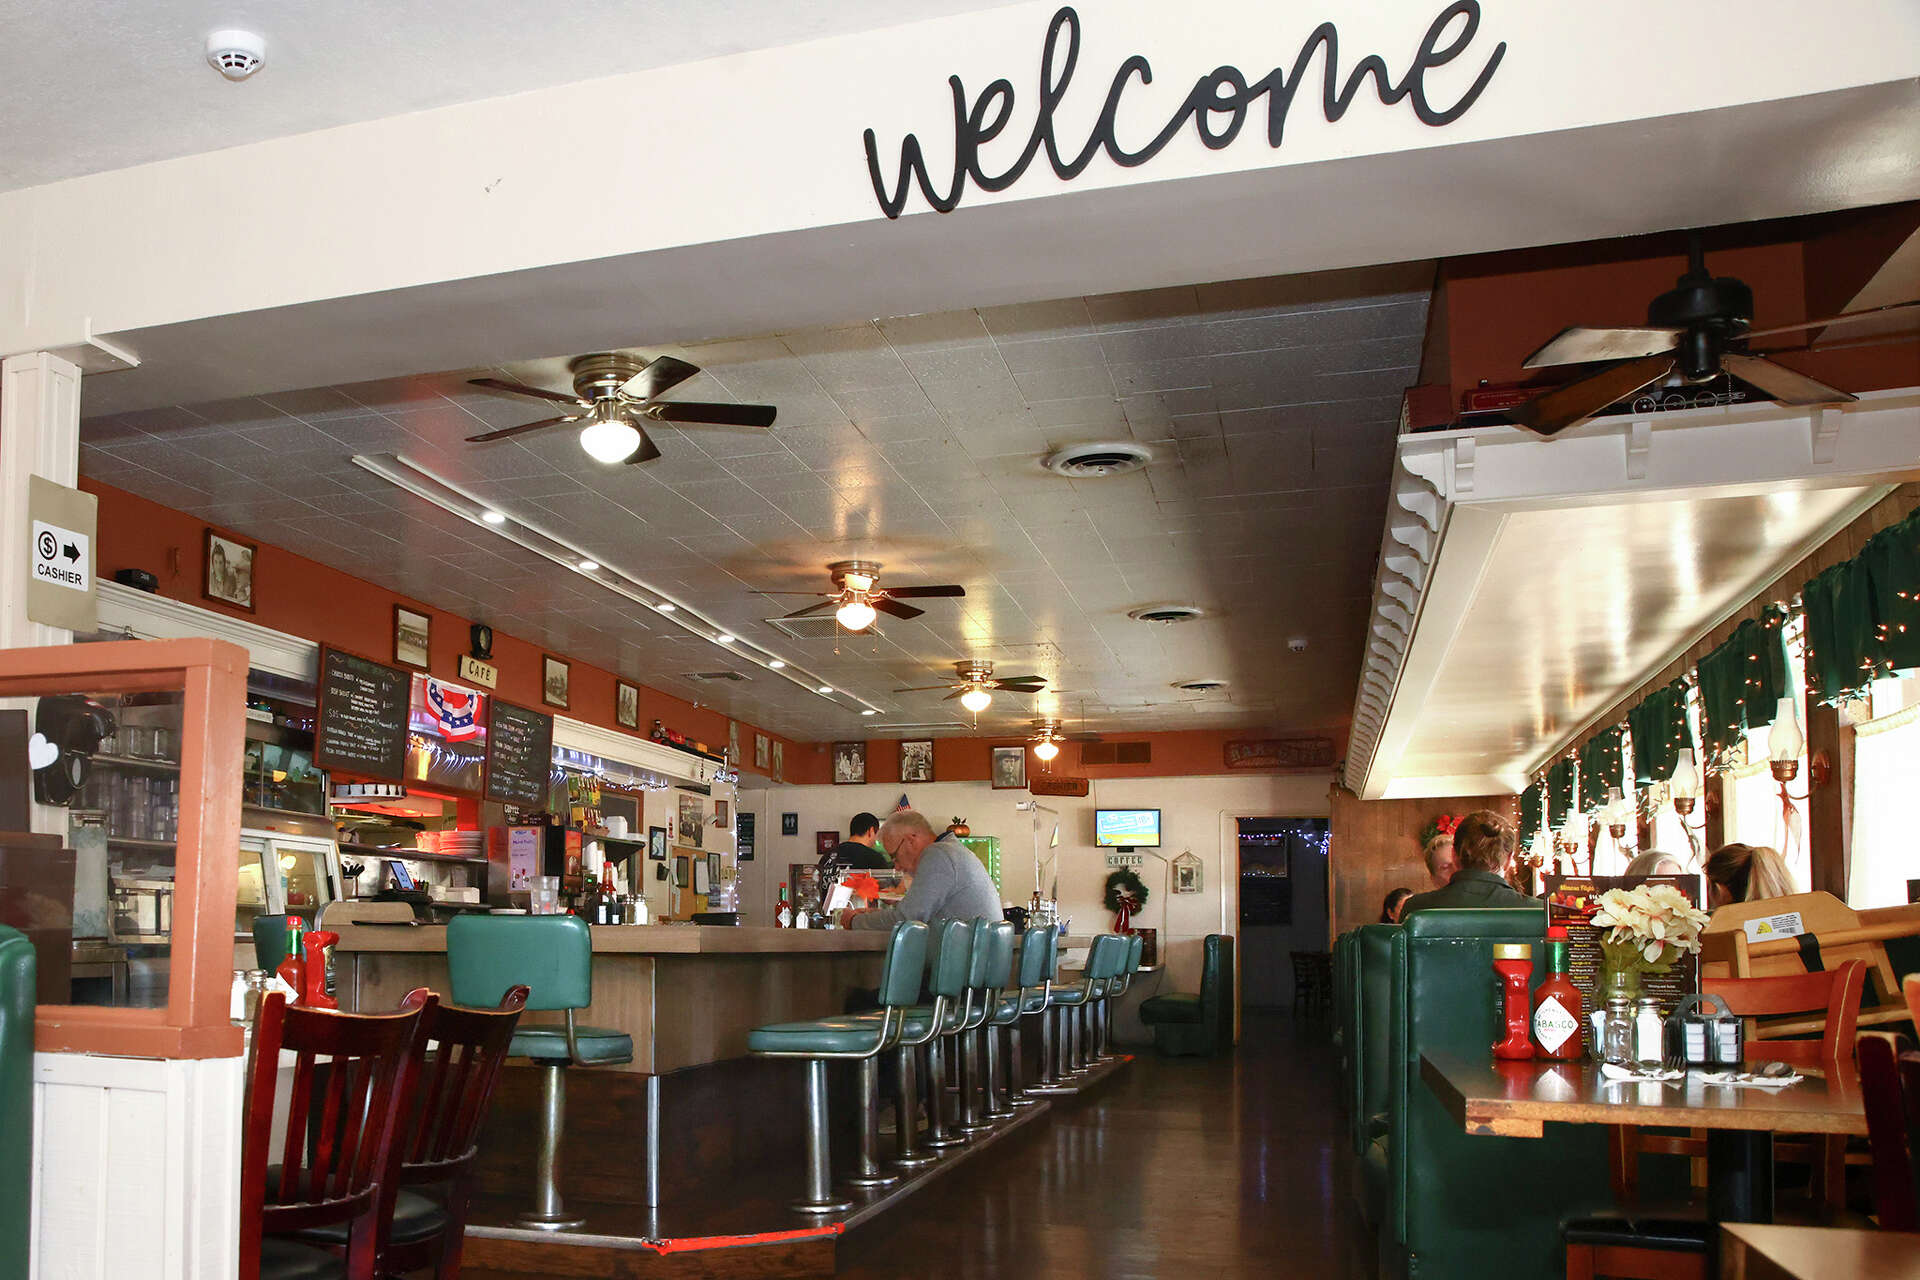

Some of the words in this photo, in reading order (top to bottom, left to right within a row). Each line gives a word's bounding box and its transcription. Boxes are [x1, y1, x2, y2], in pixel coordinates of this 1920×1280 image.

[864, 0, 1507, 220] welcome
[38, 563, 82, 586] CASHIER
[1107, 855, 1142, 865] COFFEE
